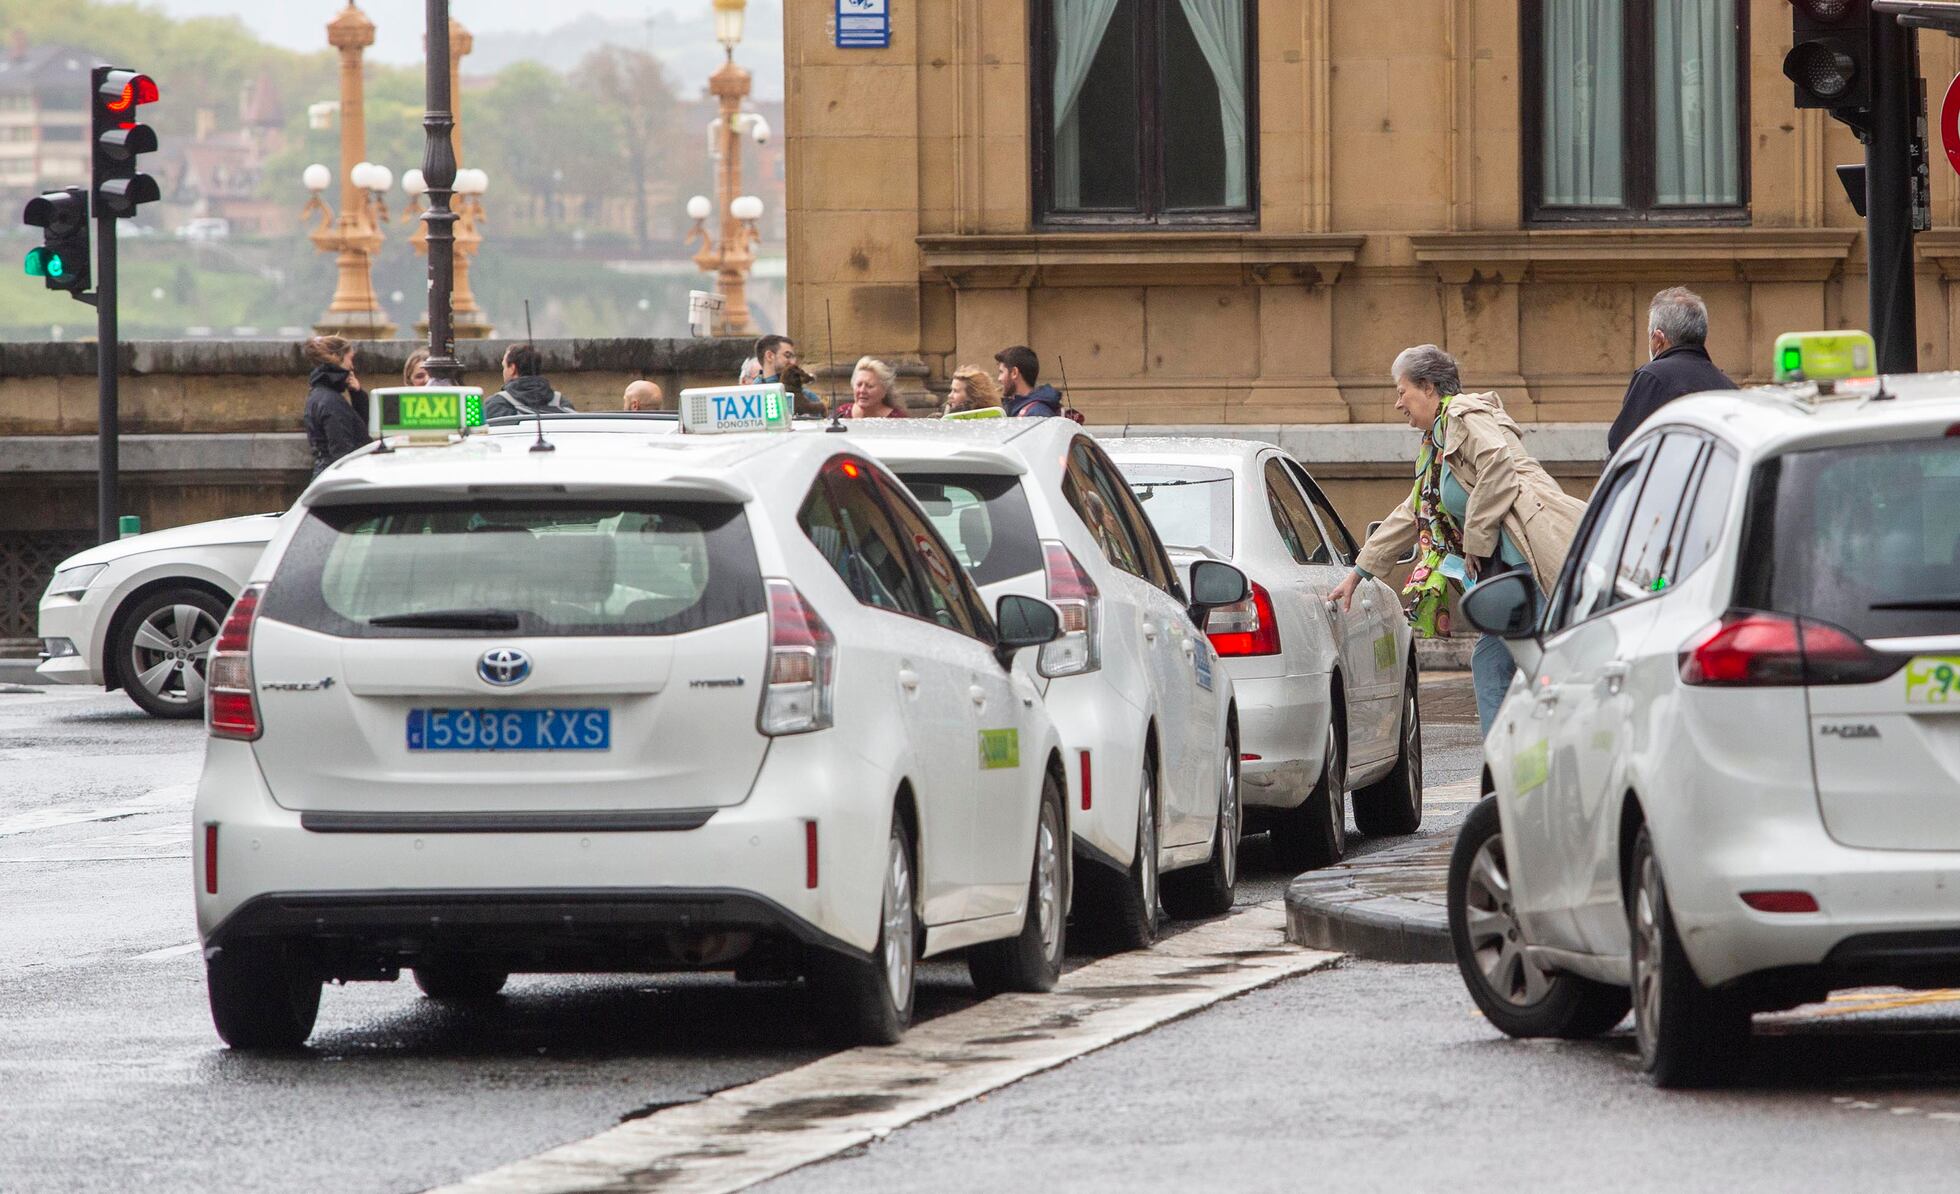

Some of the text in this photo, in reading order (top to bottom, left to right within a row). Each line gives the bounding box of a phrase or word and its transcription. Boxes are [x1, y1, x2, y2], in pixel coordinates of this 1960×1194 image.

[402, 396, 457, 418] TAXI
[712, 394, 762, 420] TAXI
[717, 420, 764, 429] DONOSTIA
[1935, 664, 1960, 693] 9
[432, 713, 604, 746] 5986 KXS
